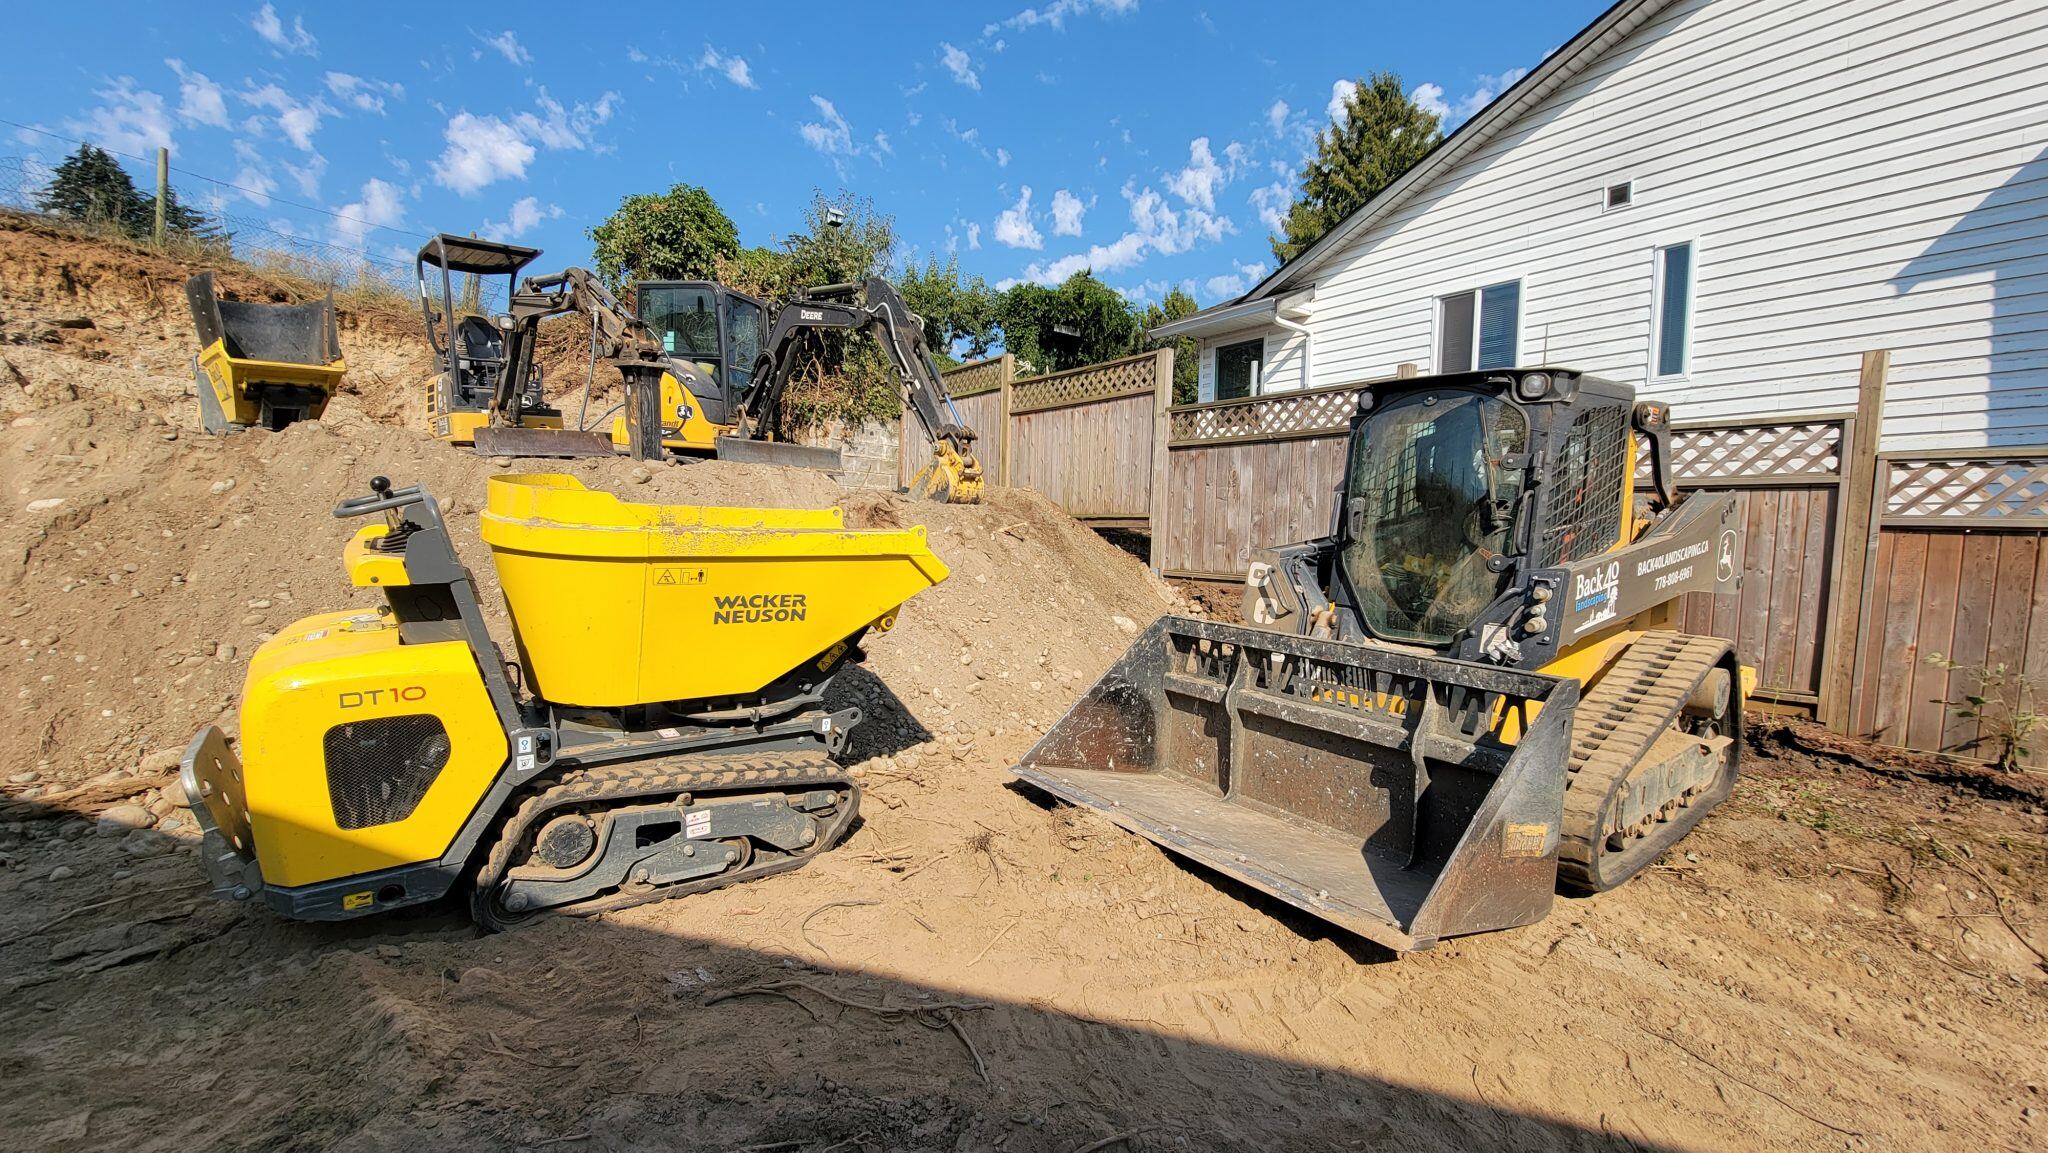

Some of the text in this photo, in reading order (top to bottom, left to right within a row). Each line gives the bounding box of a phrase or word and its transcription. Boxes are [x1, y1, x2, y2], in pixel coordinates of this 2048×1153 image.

[801, 310, 823, 320] DEERE
[1637, 540, 1709, 577] BACK40LANDSCAPING.CA
[1575, 567, 1604, 600] Back
[713, 594, 807, 609] WACKER
[1575, 591, 1608, 613] landscaping
[713, 608, 807, 625] NEUSON
